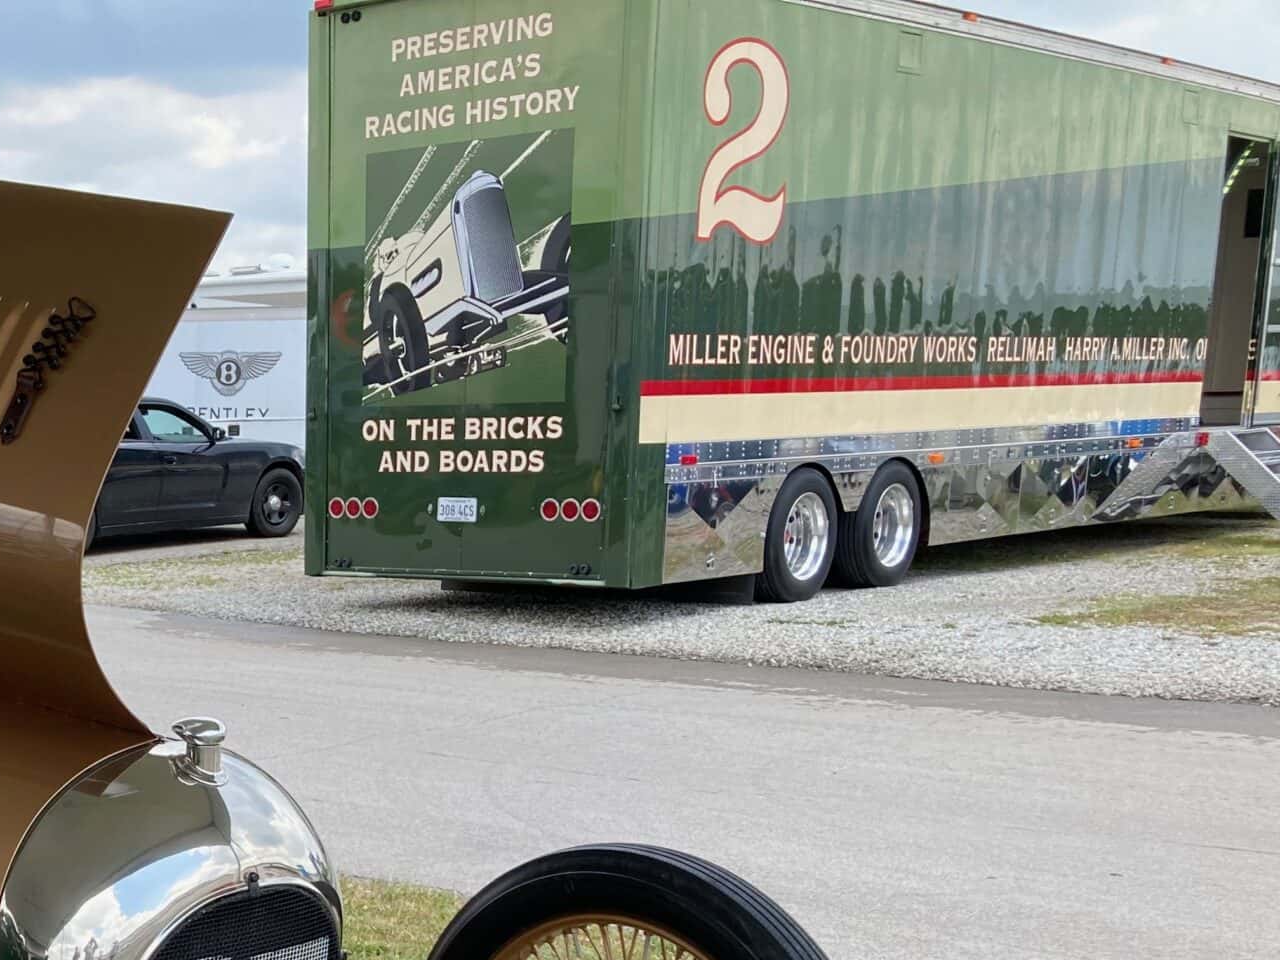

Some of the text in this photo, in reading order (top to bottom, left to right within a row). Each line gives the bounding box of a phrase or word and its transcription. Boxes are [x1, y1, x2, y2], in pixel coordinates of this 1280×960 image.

[391, 12, 553, 62] PRESERVING
[400, 53, 541, 97] AMERICA'S
[365, 85, 580, 139] RACING HISTORY
[694, 36, 790, 246] 2
[668, 333, 742, 366] MILLER
[747, 333, 817, 365] ENGINE
[821, 335, 834, 364] &
[840, 335, 918, 364] FOUNDRY
[923, 335, 977, 364] WORKS
[986, 336, 1056, 362] RELLIMAH
[1064, 337, 1108, 362] HARRY
[1122, 337, 1166, 361] MILLER
[1168, 337, 1189, 361] INC.
[362, 415, 563, 441] ON THE BRICKS
[378, 450, 545, 473] AND BOARDS
